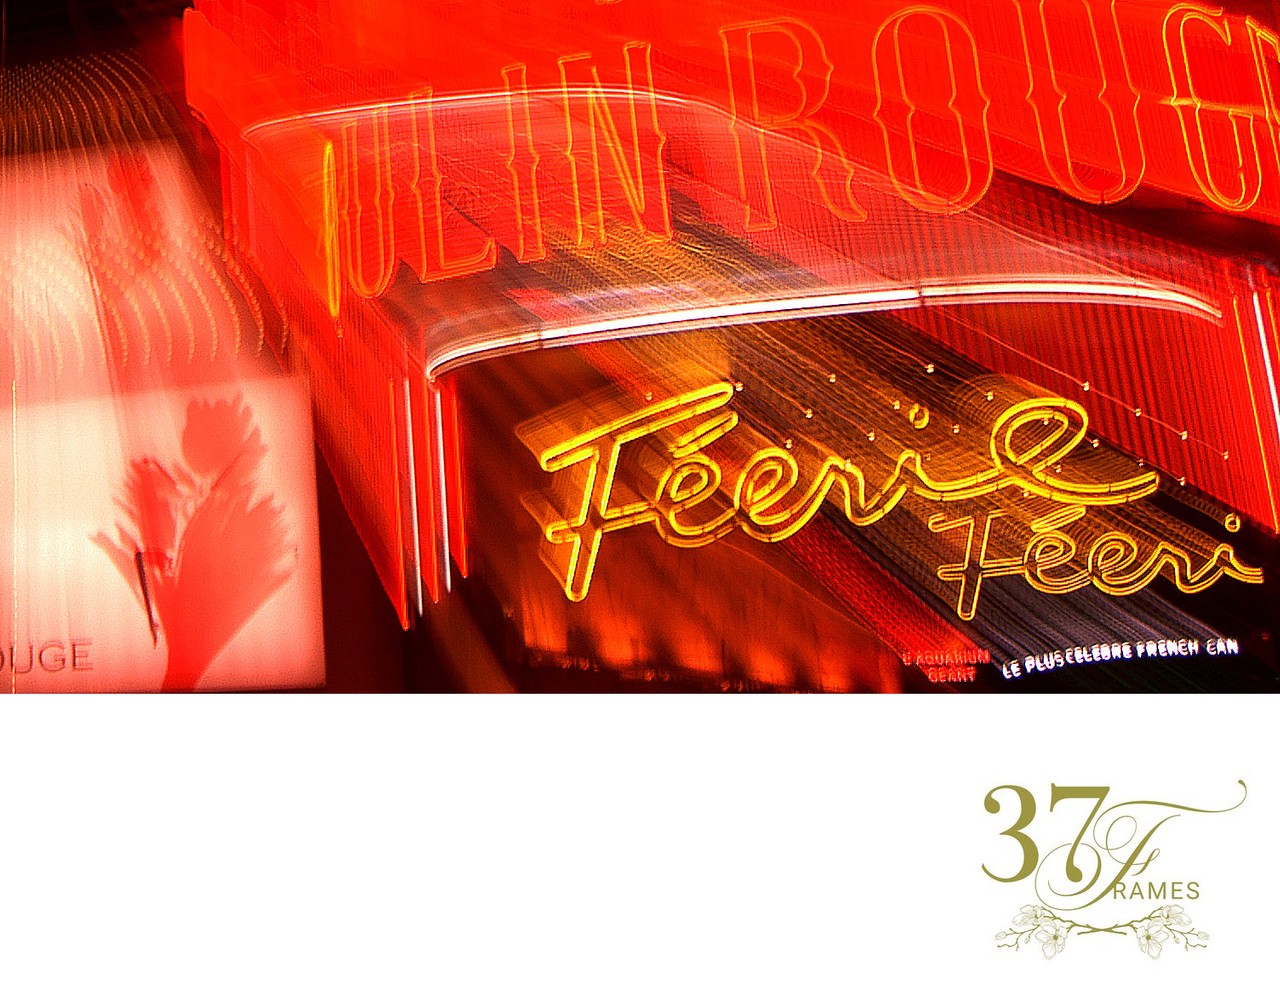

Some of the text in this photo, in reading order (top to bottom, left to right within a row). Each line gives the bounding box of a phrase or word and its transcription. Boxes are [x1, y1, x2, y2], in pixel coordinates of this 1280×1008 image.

[541, 381, 1160, 603] Féerie
[1001, 658, 1022, 680] LE
[1023, 649, 1065, 674] PLUS
[1136, 637, 1200, 659] FRENCH
[1206, 637, 1239, 657] CAN
